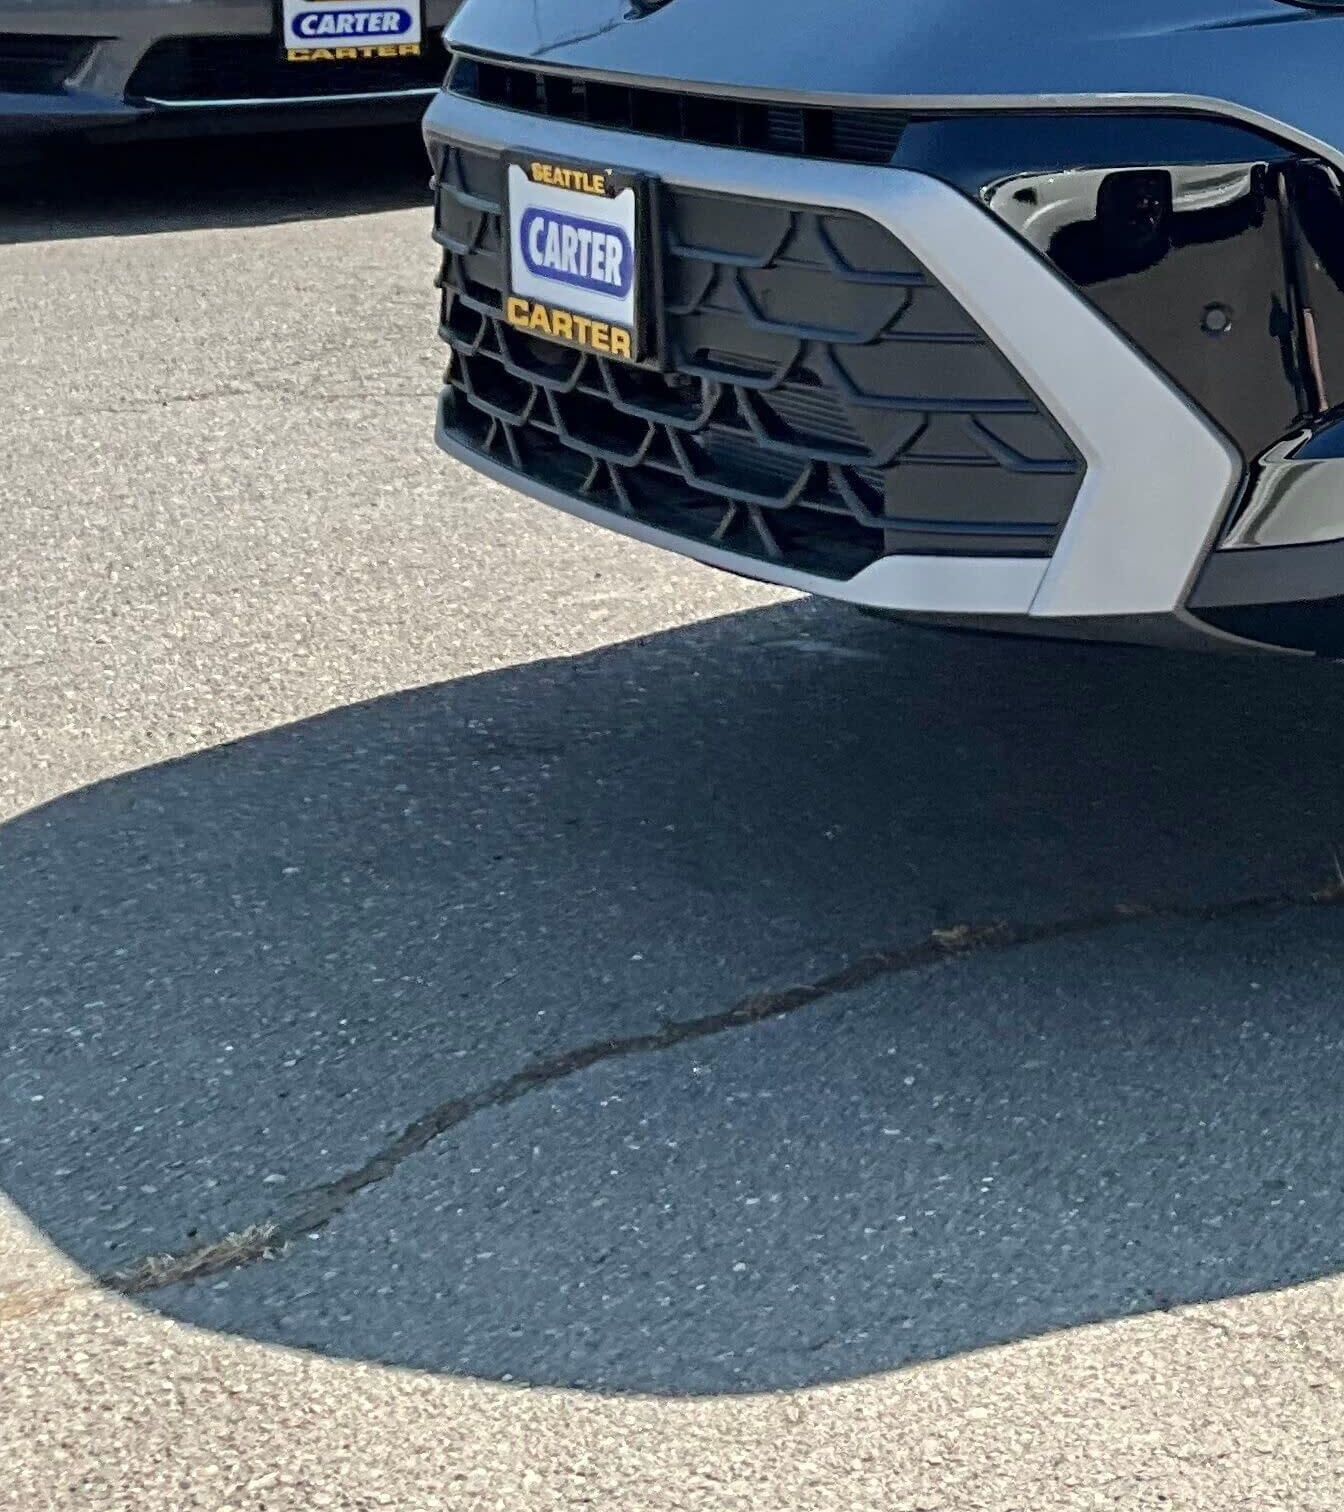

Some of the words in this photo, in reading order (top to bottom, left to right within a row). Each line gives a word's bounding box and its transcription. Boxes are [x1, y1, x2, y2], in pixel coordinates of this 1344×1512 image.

[300, 11, 400, 36] CARTER
[287, 43, 420, 61] CARTER
[530, 162, 605, 194] SEATTLE
[528, 217, 623, 286] CARTER
[506, 297, 632, 359] CARTER
